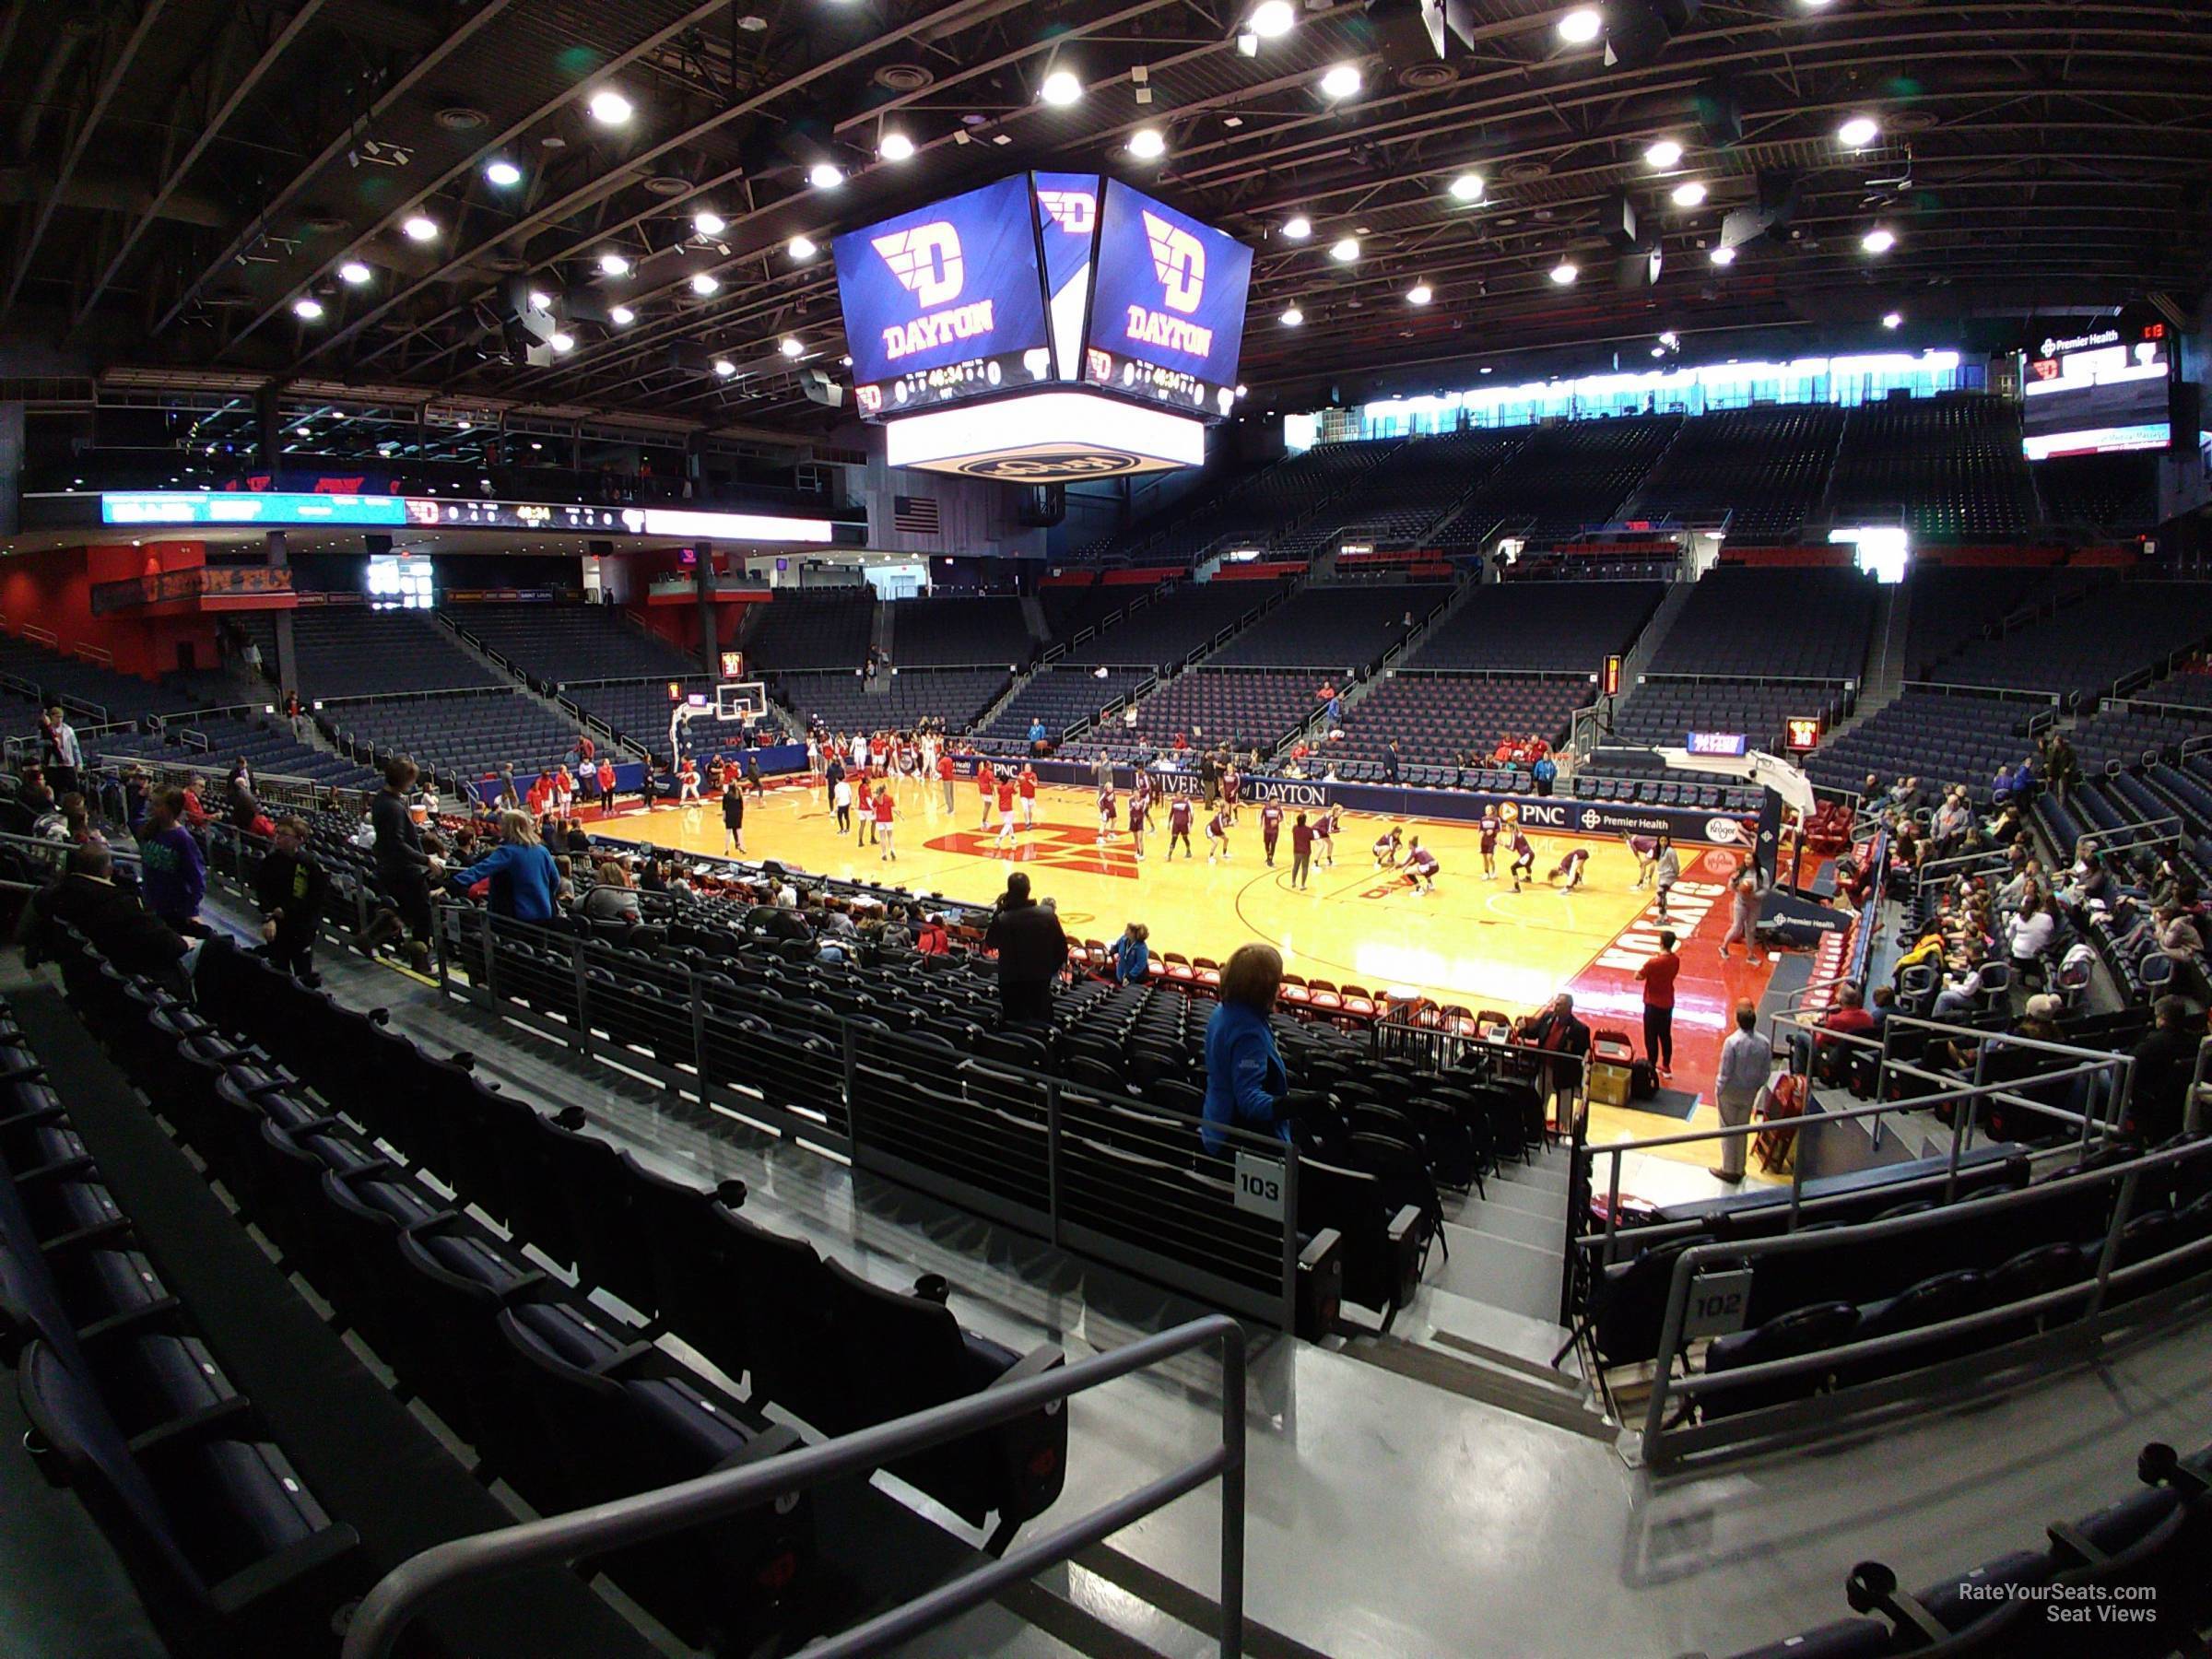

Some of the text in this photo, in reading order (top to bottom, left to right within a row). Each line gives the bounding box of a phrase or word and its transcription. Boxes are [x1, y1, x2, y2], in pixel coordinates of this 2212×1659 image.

[882, 299, 994, 360] DAYTON
[1126, 304, 1213, 359] DAYTON
[2056, 329, 2119, 351] Premier Health
[987, 360, 1002, 385] 0
[895, 381, 908, 404] 0
[994, 763, 1018, 778] PNC
[1241, 782, 1250, 795] of
[1254, 782, 1325, 806] DAYTON
[1522, 805, 1565, 825] PNC
[1604, 816, 1668, 830] Premier Health
[1710, 820, 1736, 840] Kroger
[1787, 916, 1812, 926] Premier
[1241, 1172, 1279, 1202] 103
[1697, 1294, 1741, 1318] 102
